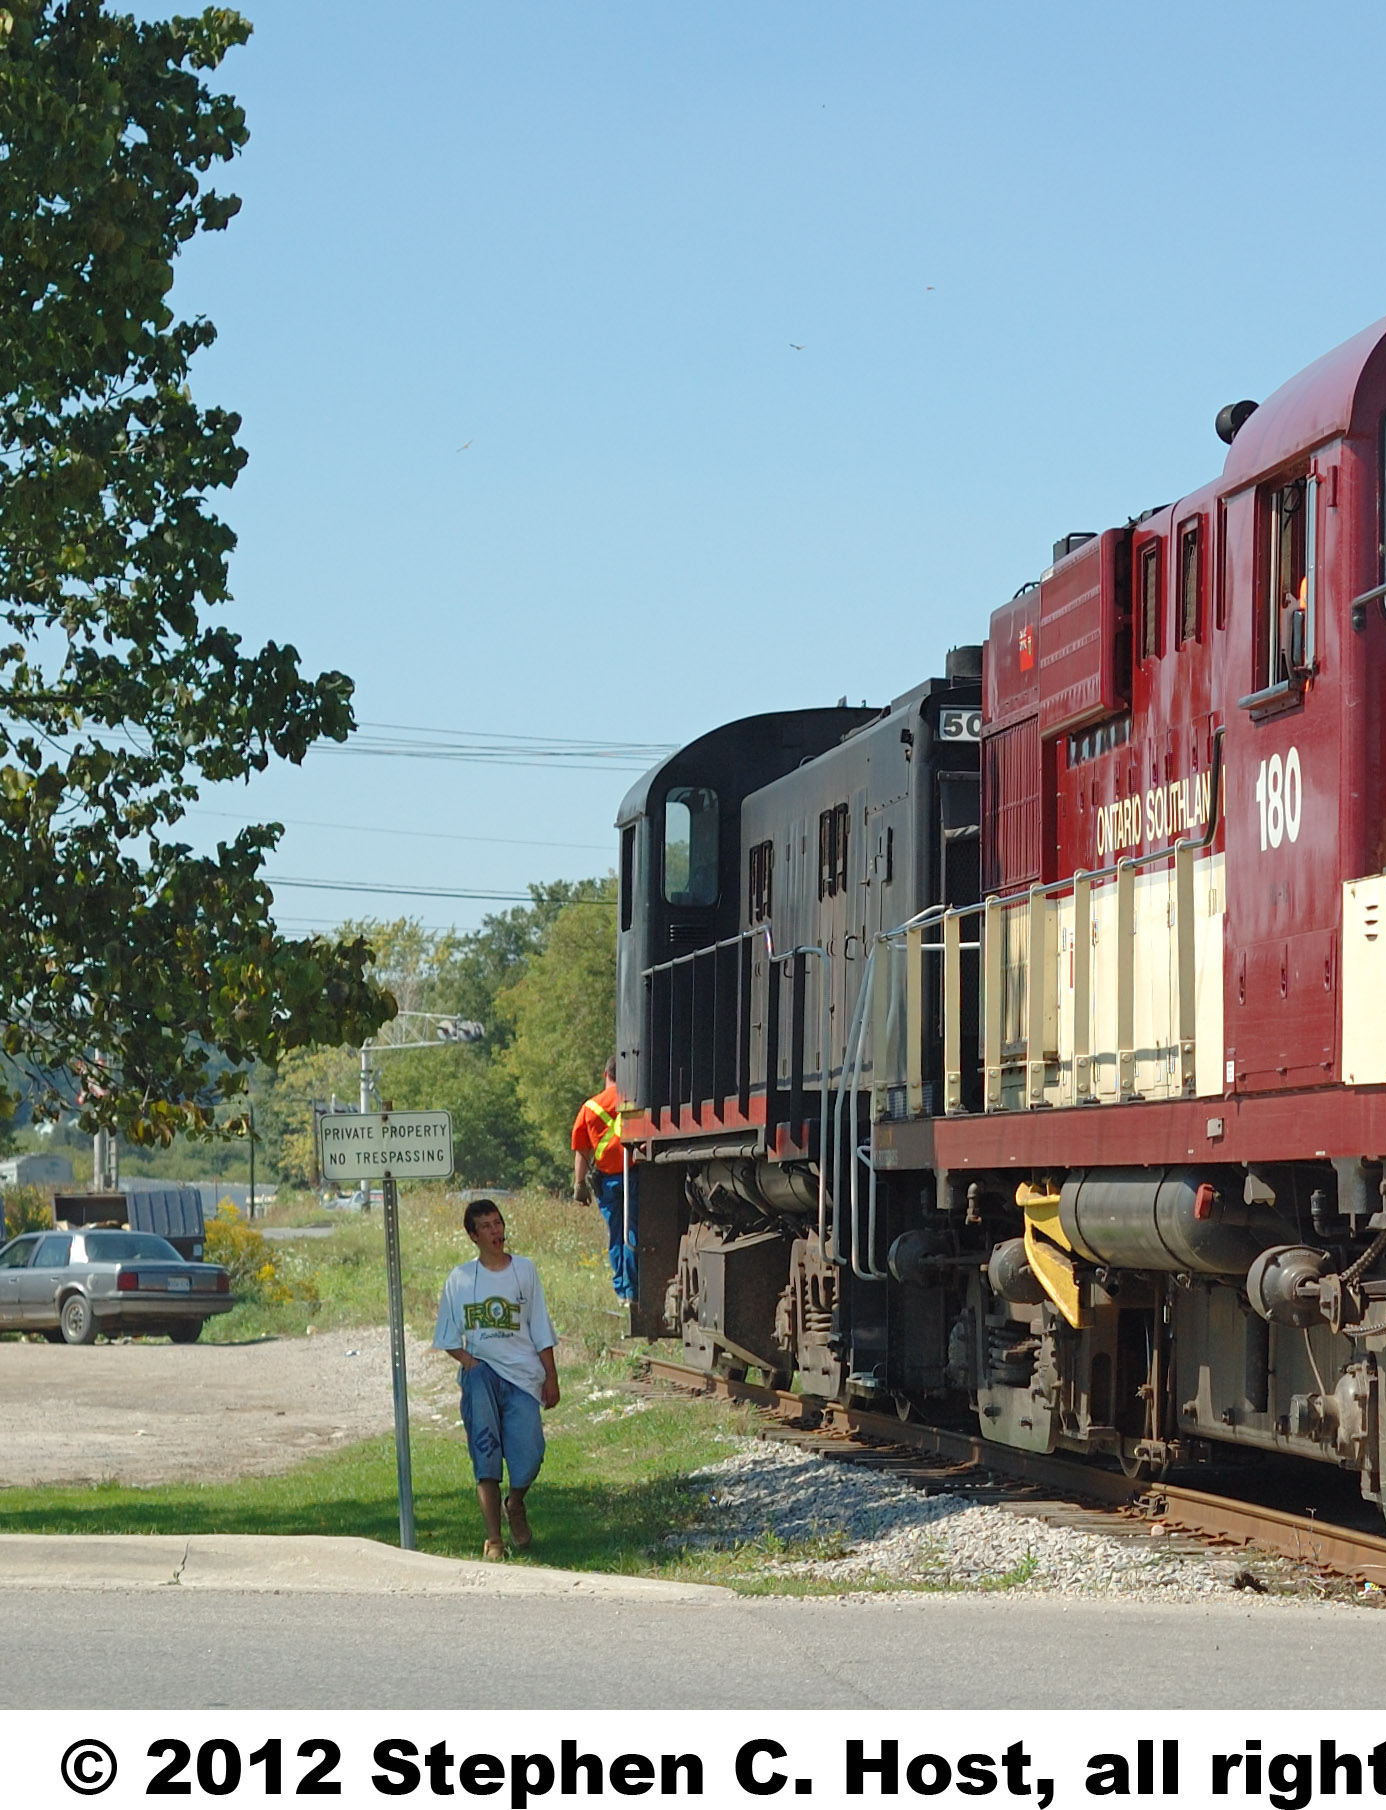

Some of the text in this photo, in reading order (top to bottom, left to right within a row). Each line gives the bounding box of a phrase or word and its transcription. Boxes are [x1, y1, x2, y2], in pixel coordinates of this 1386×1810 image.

[1097, 793, 1142, 856] ONTARIO
[1146, 770, 1212, 841] SOUTHLAN
[1256, 746, 1302, 852] 180
[324, 1124, 447, 1141] PRIVATE PROPERTY
[329, 1149, 444, 1166] NO TRESPASSING
